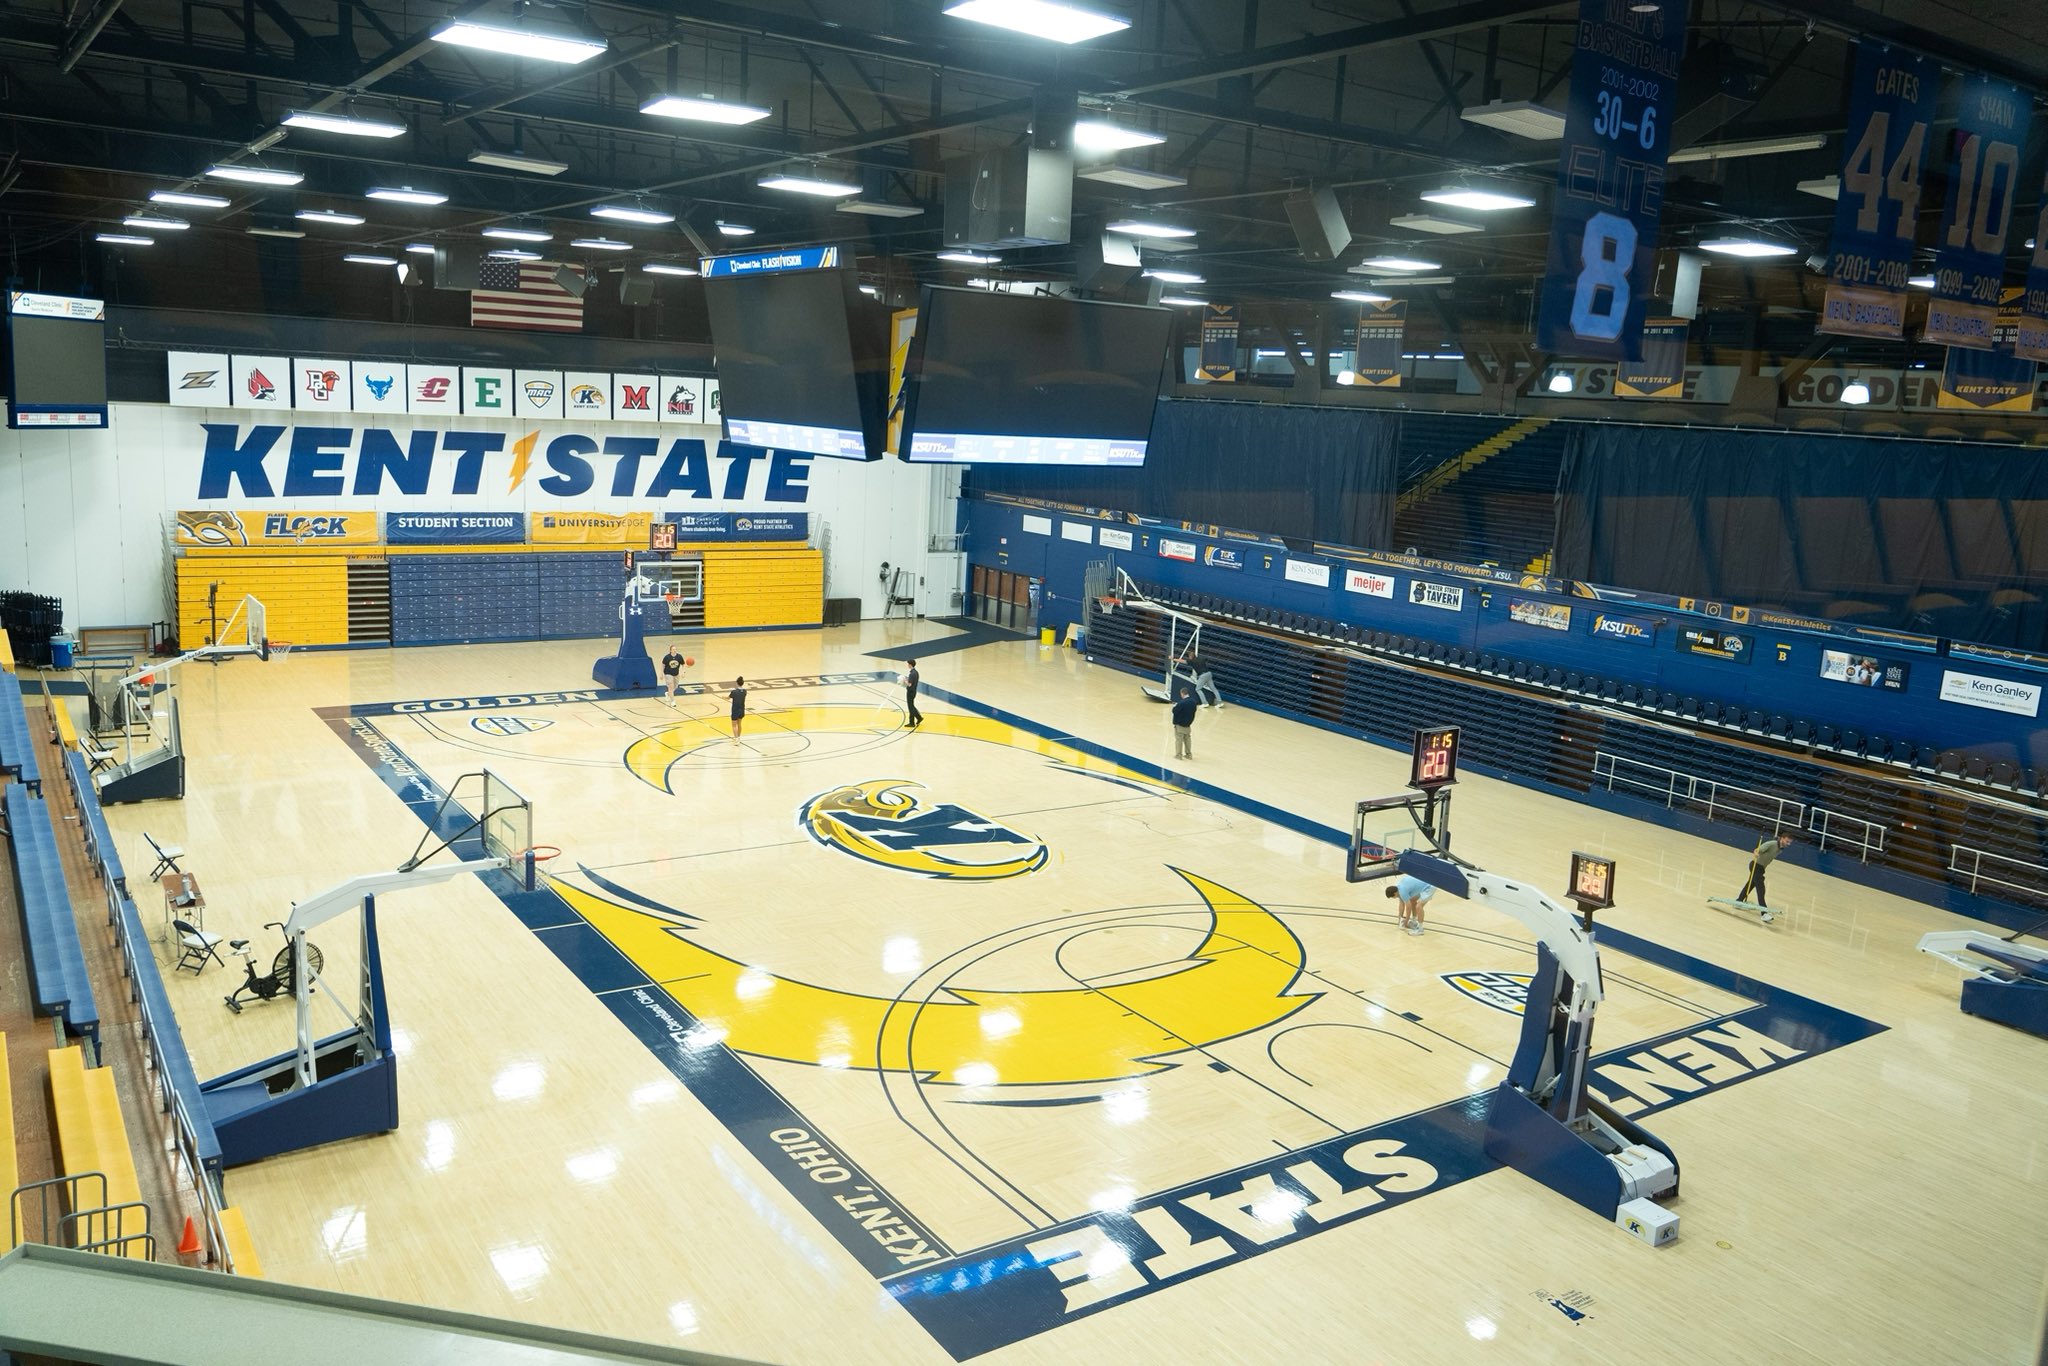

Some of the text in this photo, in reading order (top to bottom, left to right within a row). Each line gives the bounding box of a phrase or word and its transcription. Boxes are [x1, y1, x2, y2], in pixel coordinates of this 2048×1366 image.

[1579, 20, 1679, 80] BASKETBALL
[1602, 66, 1658, 101] 2001-2002
[1876, 68, 1920, 104] GATES
[1979, 96, 2016, 129] SHAW
[1567, 144, 1664, 217] ELITE
[1844, 111, 1928, 240] 44
[1947, 135, 2019, 255] 10
[1569, 211, 1638, 343] 8
[1835, 254, 1908, 289] 2001-2003
[1936, 268, 2000, 301] 1999-2002
[1828, 300, 1900, 327] MEN'S BASKETBALL
[1953, 315, 1992, 338] BASKETBALL
[474, 378, 502, 408] E
[1648, 376, 1673, 384] STATE
[1956, 384, 2017, 395] KENT STATE
[622, 385, 650, 410] M
[198, 424, 506, 500] KENT
[538, 434, 815, 502] STATE
[264, 517, 348, 537] FLOCK
[398, 517, 513, 528] STUDENT SECTION
[656, 534, 672, 547] 20
[1372, 552, 1512, 581] ALL TOGETHER, LET'S GO FORWARD. KSU.
[1354, 575, 1386, 593] meijer
[1426, 590, 1459, 606] TAVERN
[1428, 584, 1461, 594] WATER STREET
[1761, 614, 1832, 631] @KentStAthletics
[1778, 651, 1787, 661] B
[393, 672, 875, 713] GOLDEN FLASHES
[1972, 680, 1993, 692] Ken
[1994, 684, 2032, 700] Ganley
[1432, 733, 1452, 749] 1:15
[1423, 750, 1447, 779] 20
[1581, 876, 1601, 894] 20
[769, 1128, 942, 1265] KENT, OHIO
[1025, 1138, 1438, 1313] STATE
